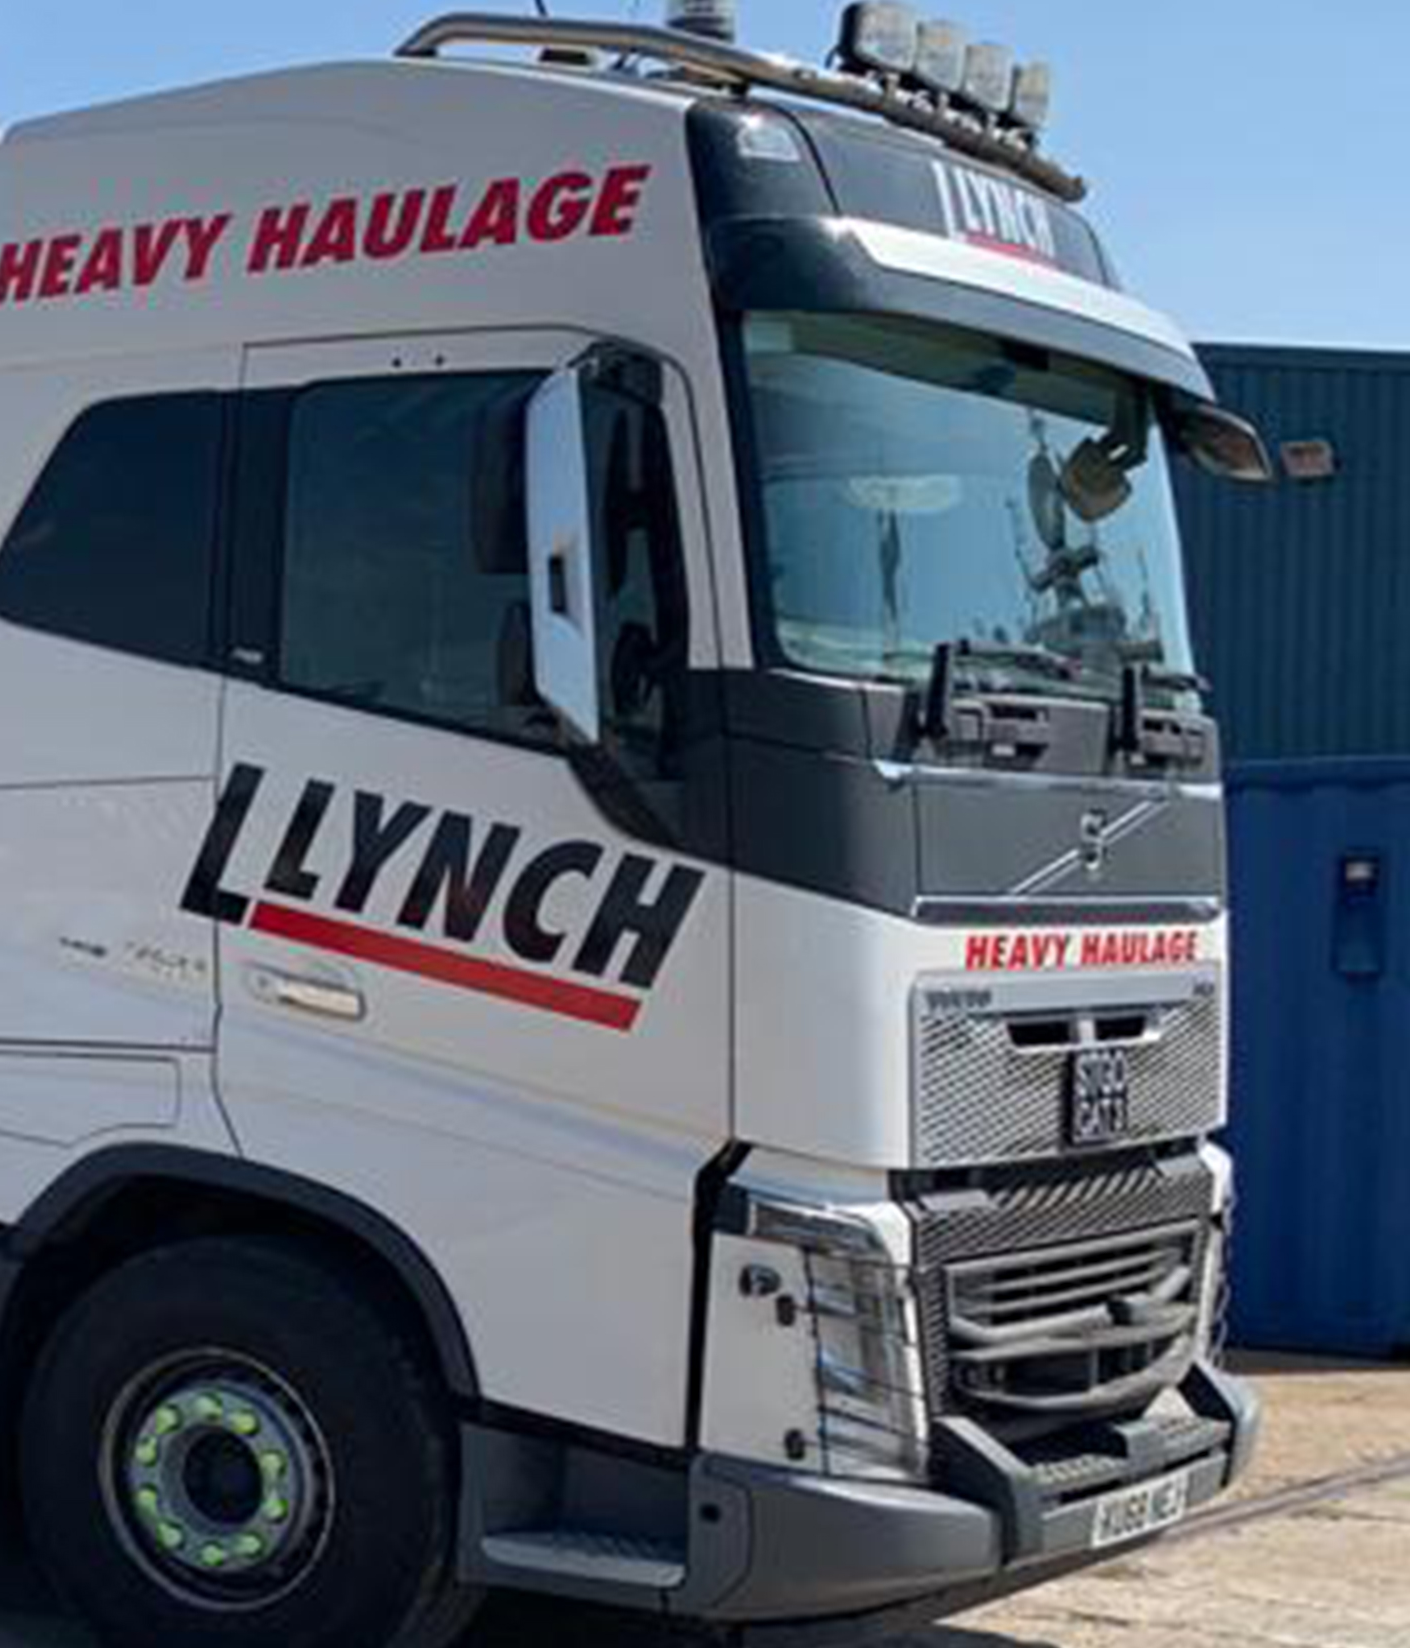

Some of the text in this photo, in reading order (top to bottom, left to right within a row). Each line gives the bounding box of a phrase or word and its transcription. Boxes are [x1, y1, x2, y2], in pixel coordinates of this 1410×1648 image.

[247, 164, 651, 275] HAULAGE
[965, 930, 1199, 970] HEAVY HAULAGE
